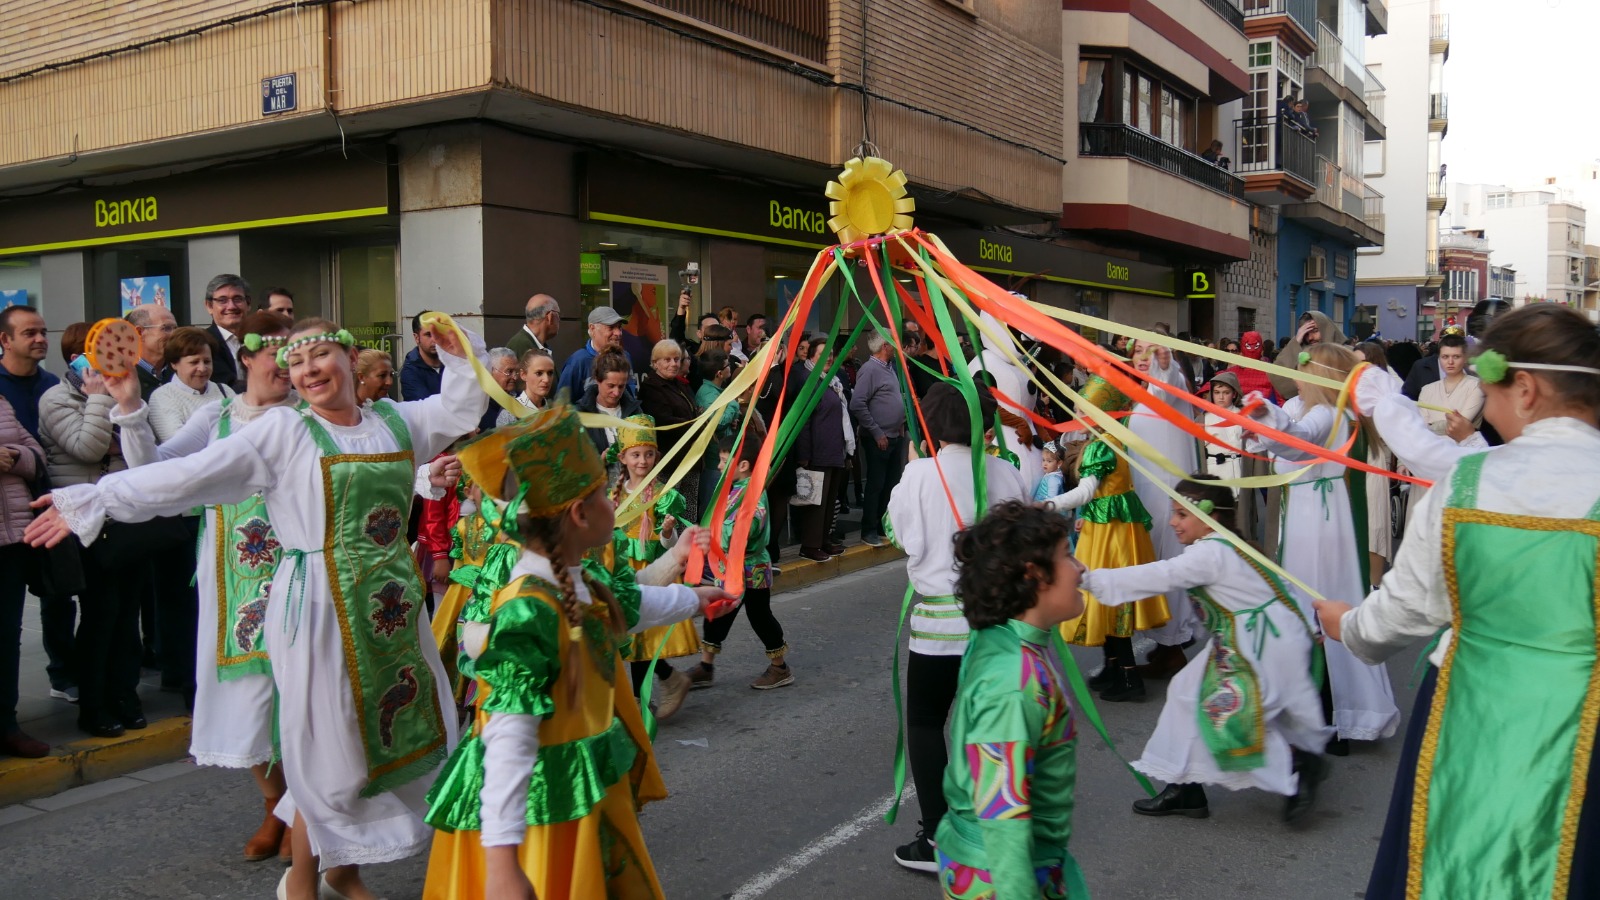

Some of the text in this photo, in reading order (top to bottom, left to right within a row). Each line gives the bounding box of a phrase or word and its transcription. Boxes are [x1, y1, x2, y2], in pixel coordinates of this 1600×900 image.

[271, 76, 293, 89] PUERTA
[275, 87, 288, 95] DEL
[270, 94, 287, 110] MAR
[95, 196, 158, 227] Bankia
[769, 199, 825, 234] Bankia
[979, 238, 1013, 263] Bankia
[1106, 262, 1129, 281] Bankia
[1192, 271, 1209, 291] B
